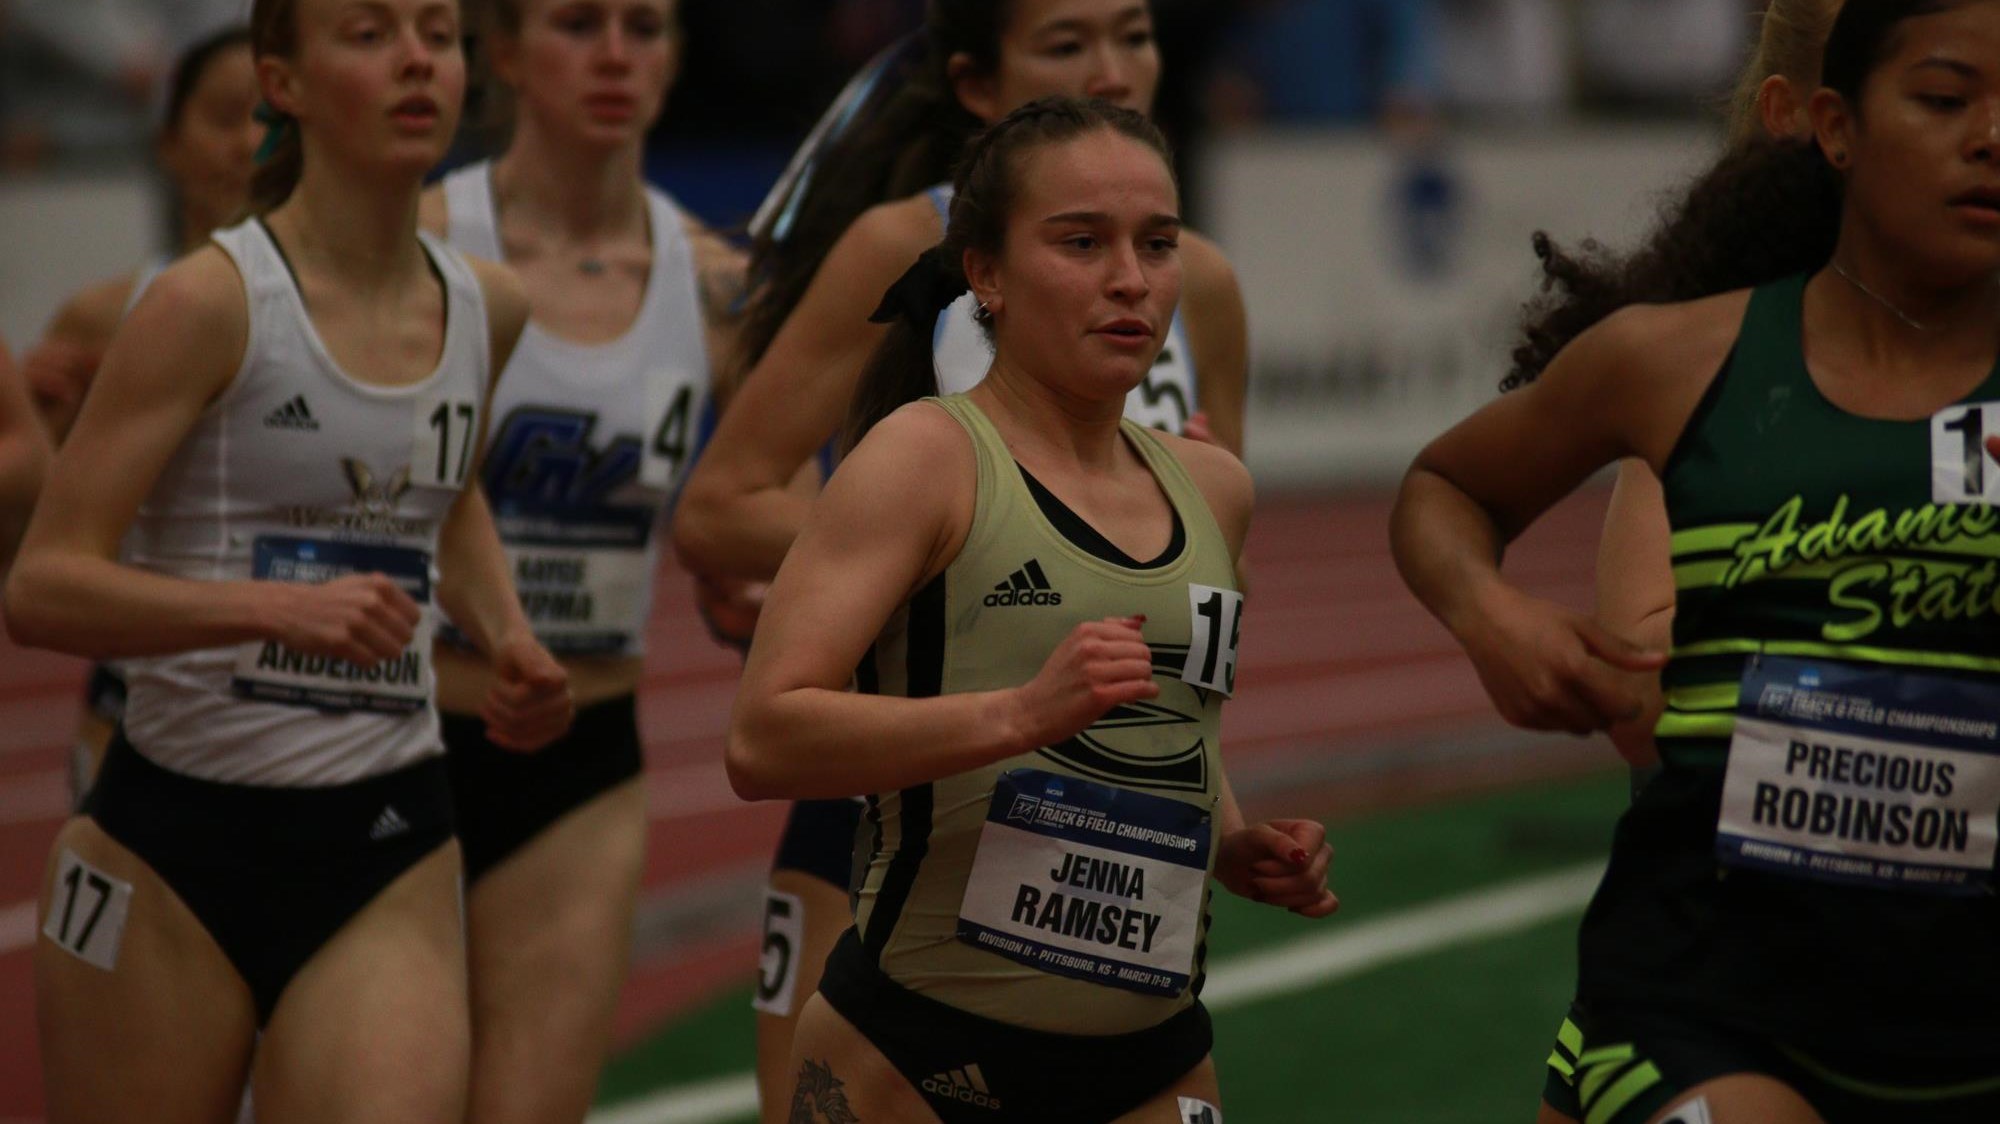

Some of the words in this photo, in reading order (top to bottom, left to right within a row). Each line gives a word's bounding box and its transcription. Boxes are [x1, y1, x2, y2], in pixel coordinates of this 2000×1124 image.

[431, 402, 474, 483] 17
[655, 386, 691, 480] 4
[983, 588, 1062, 607] adidas
[1821, 560, 2000, 642] Stat
[1785, 740, 1955, 797] PRECIOUS
[1037, 806, 1076, 826] TRACK
[1075, 814, 1086, 828] &
[1085, 816, 1116, 835] FIELD
[1116, 822, 1197, 852] CHAMPIONSHIPS
[1753, 781, 1969, 852] ROBINSON
[1050, 852, 1145, 900] JENNA
[60, 864, 112, 953] 17
[1011, 884, 1161, 953] RAMSEY
[977, 931, 1024, 954] DIVISION
[1097, 960, 1112, 976] KS
[1118, 966, 1150, 985] MARCH
[921, 1076, 1001, 1111] adidas
